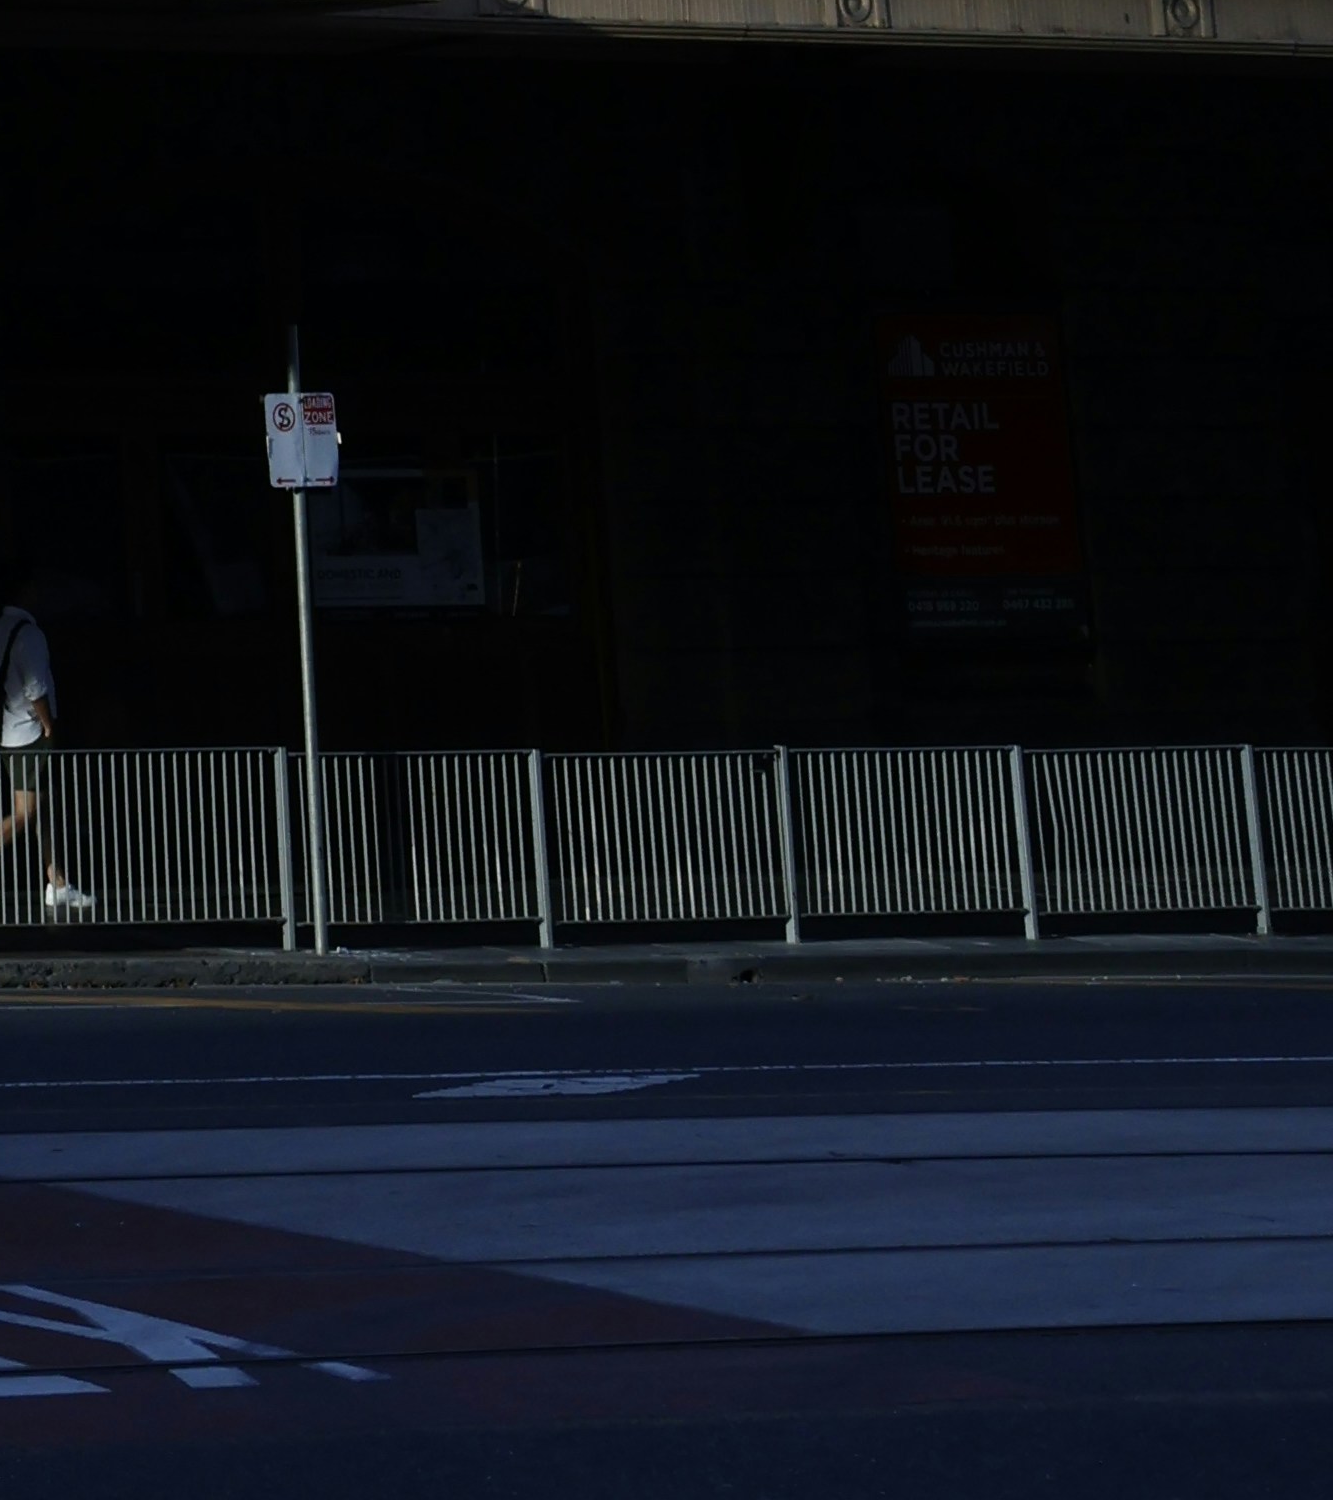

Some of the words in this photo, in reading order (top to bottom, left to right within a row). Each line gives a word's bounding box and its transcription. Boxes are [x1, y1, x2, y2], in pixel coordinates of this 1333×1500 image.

[939, 341, 1030, 358] CUSHMAN
[1035, 342, 1046, 358] &
[940, 361, 1050, 377] WAKEFIELD
[304, 411, 334, 423] ZONE
[891, 401, 1000, 431] RETAIL
[893, 433, 960, 462] FOR
[897, 465, 997, 494] LEASE
